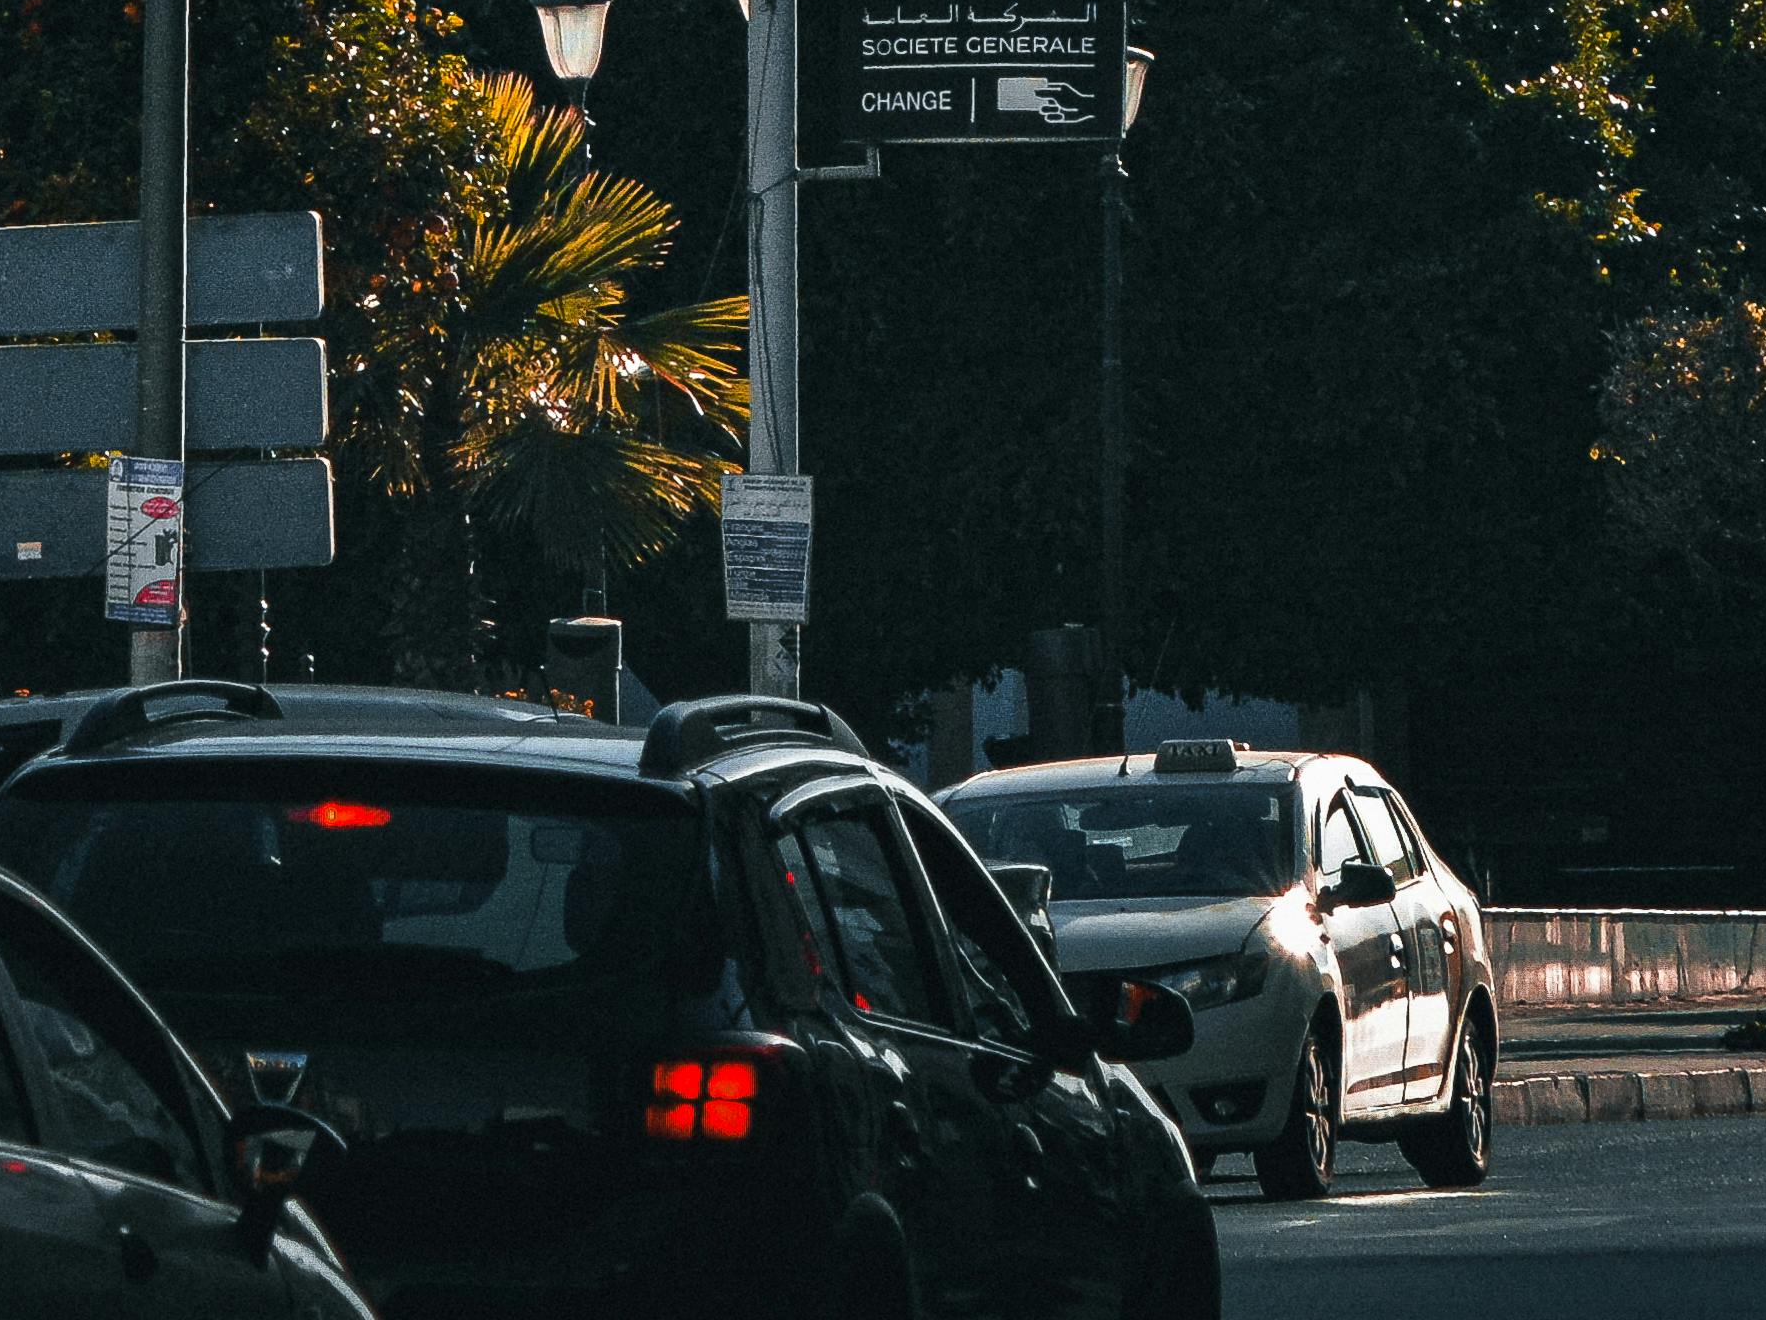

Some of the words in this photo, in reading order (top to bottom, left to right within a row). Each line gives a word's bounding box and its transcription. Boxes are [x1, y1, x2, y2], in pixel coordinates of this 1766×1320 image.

[863, 3, 959, 25] العامة
[968, 2, 1097, 32] الشركة
[862, 36, 958, 56] SOCIETE
[966, 36, 1096, 55] GENERALE
[862, 90, 952, 112] CHANGE
[1169, 743, 1219, 757] TAXI
